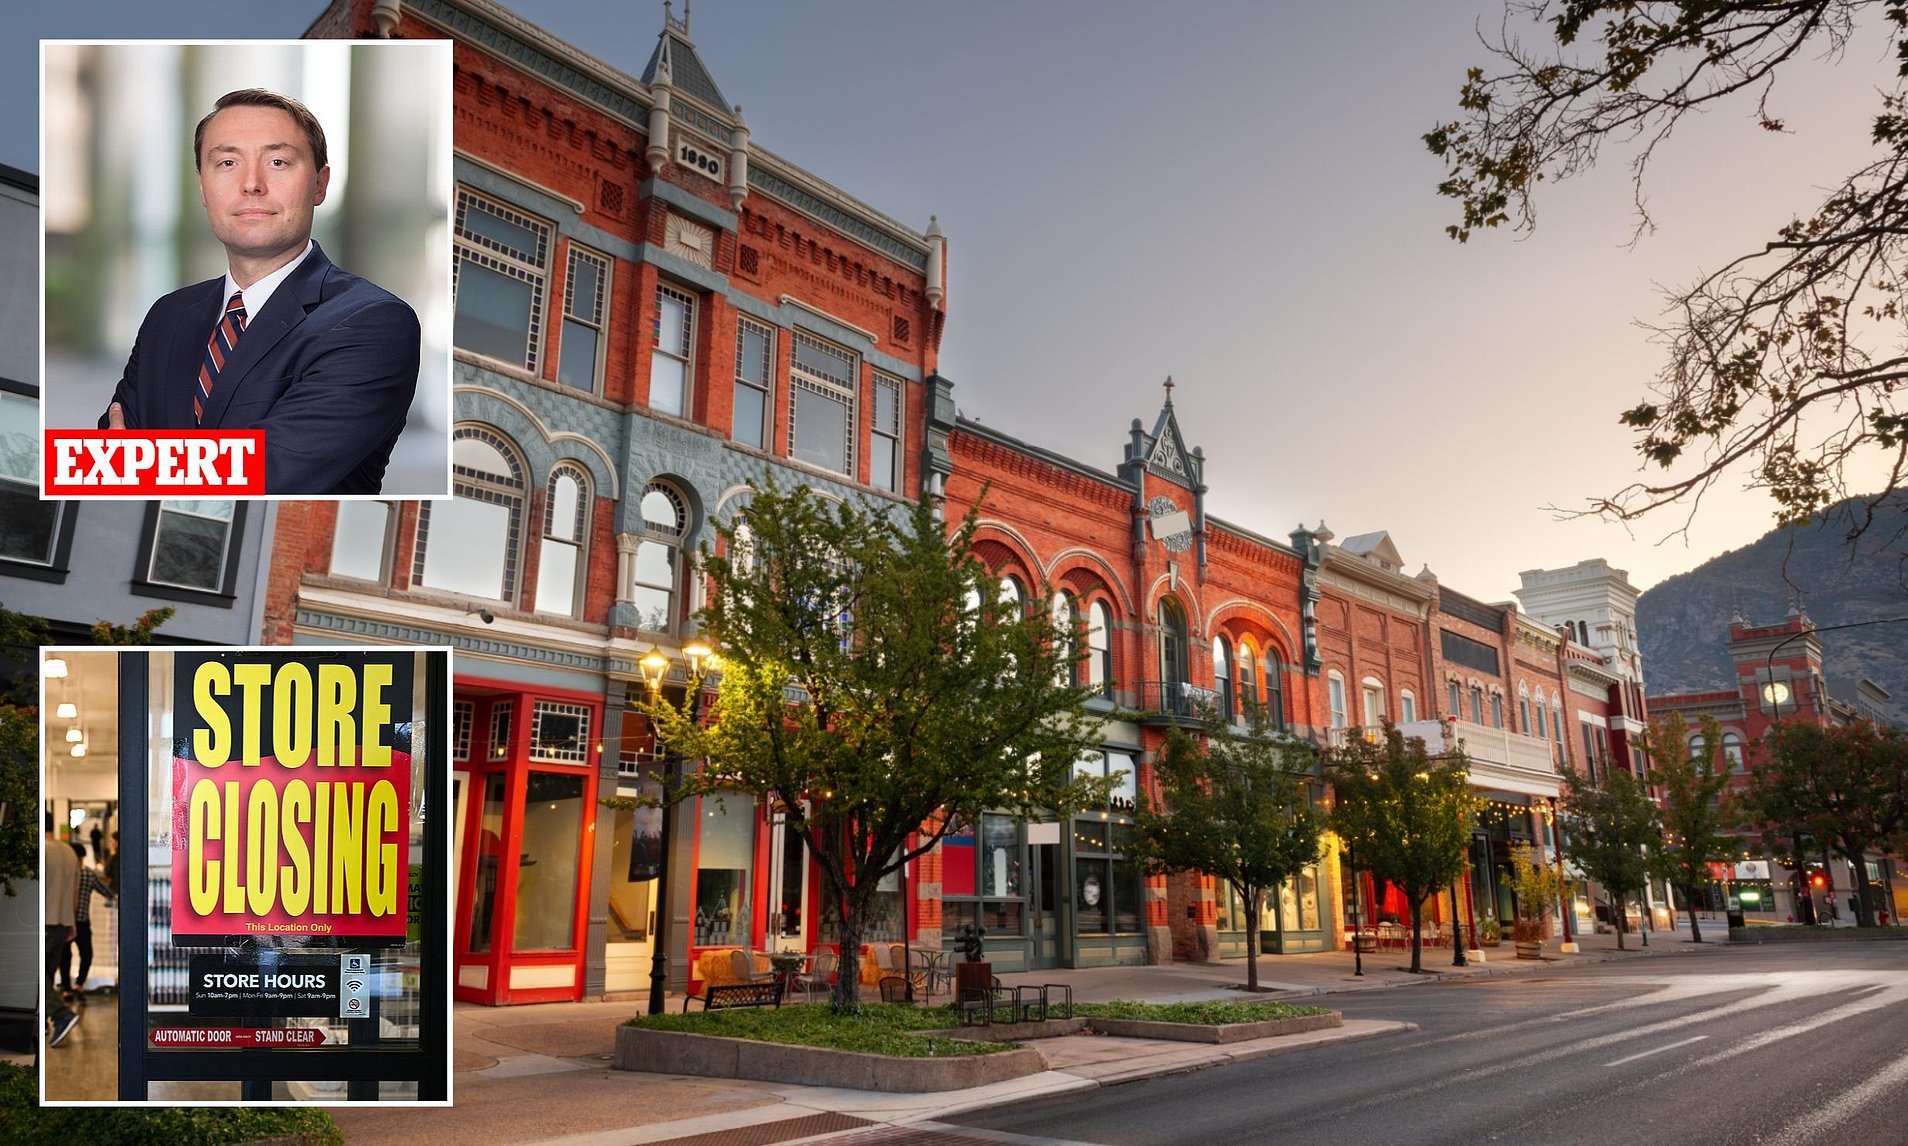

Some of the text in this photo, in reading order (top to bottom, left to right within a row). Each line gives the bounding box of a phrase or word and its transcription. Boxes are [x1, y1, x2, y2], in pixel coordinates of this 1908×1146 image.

[681, 144, 719, 175] 1890
[193, 661, 393, 768] STORE
[189, 779, 398, 917] CLOSING
[246, 922, 332, 934] This Location Only
[203, 974, 326, 989] STORE HOURS
[207, 992, 239, 1000] 10am-7pm
[264, 992, 293, 1000] 9am-9pm
[306, 992, 336, 1000] 9am-9pm
[154, 1030, 315, 1043] AUTOMATIC DOOR STAND CLEAR
